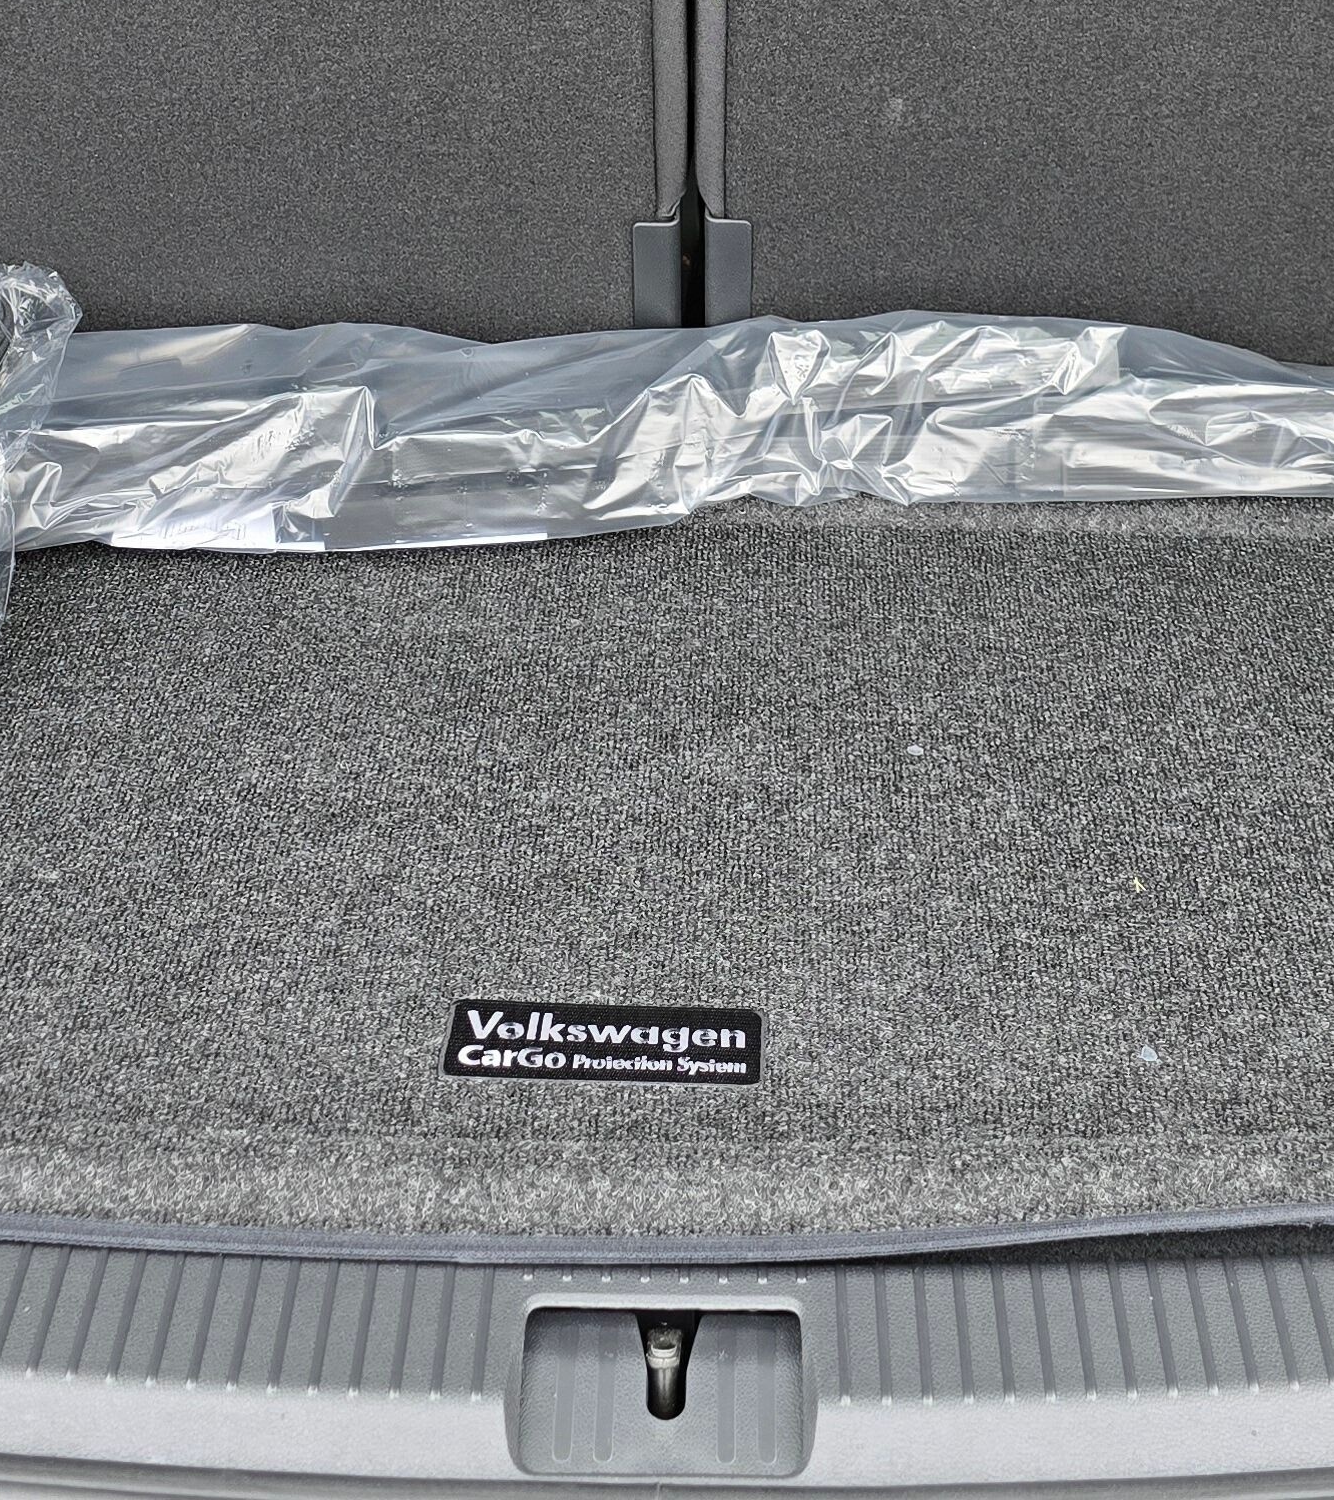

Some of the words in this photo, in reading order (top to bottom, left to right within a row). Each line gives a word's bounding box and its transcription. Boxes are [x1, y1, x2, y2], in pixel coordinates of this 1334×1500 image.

[466, 1009, 746, 1053] Volkswagen
[457, 1045, 567, 1069] CarGo
[572, 1054, 673, 1072] Protection
[676, 1056, 747, 1075] System
